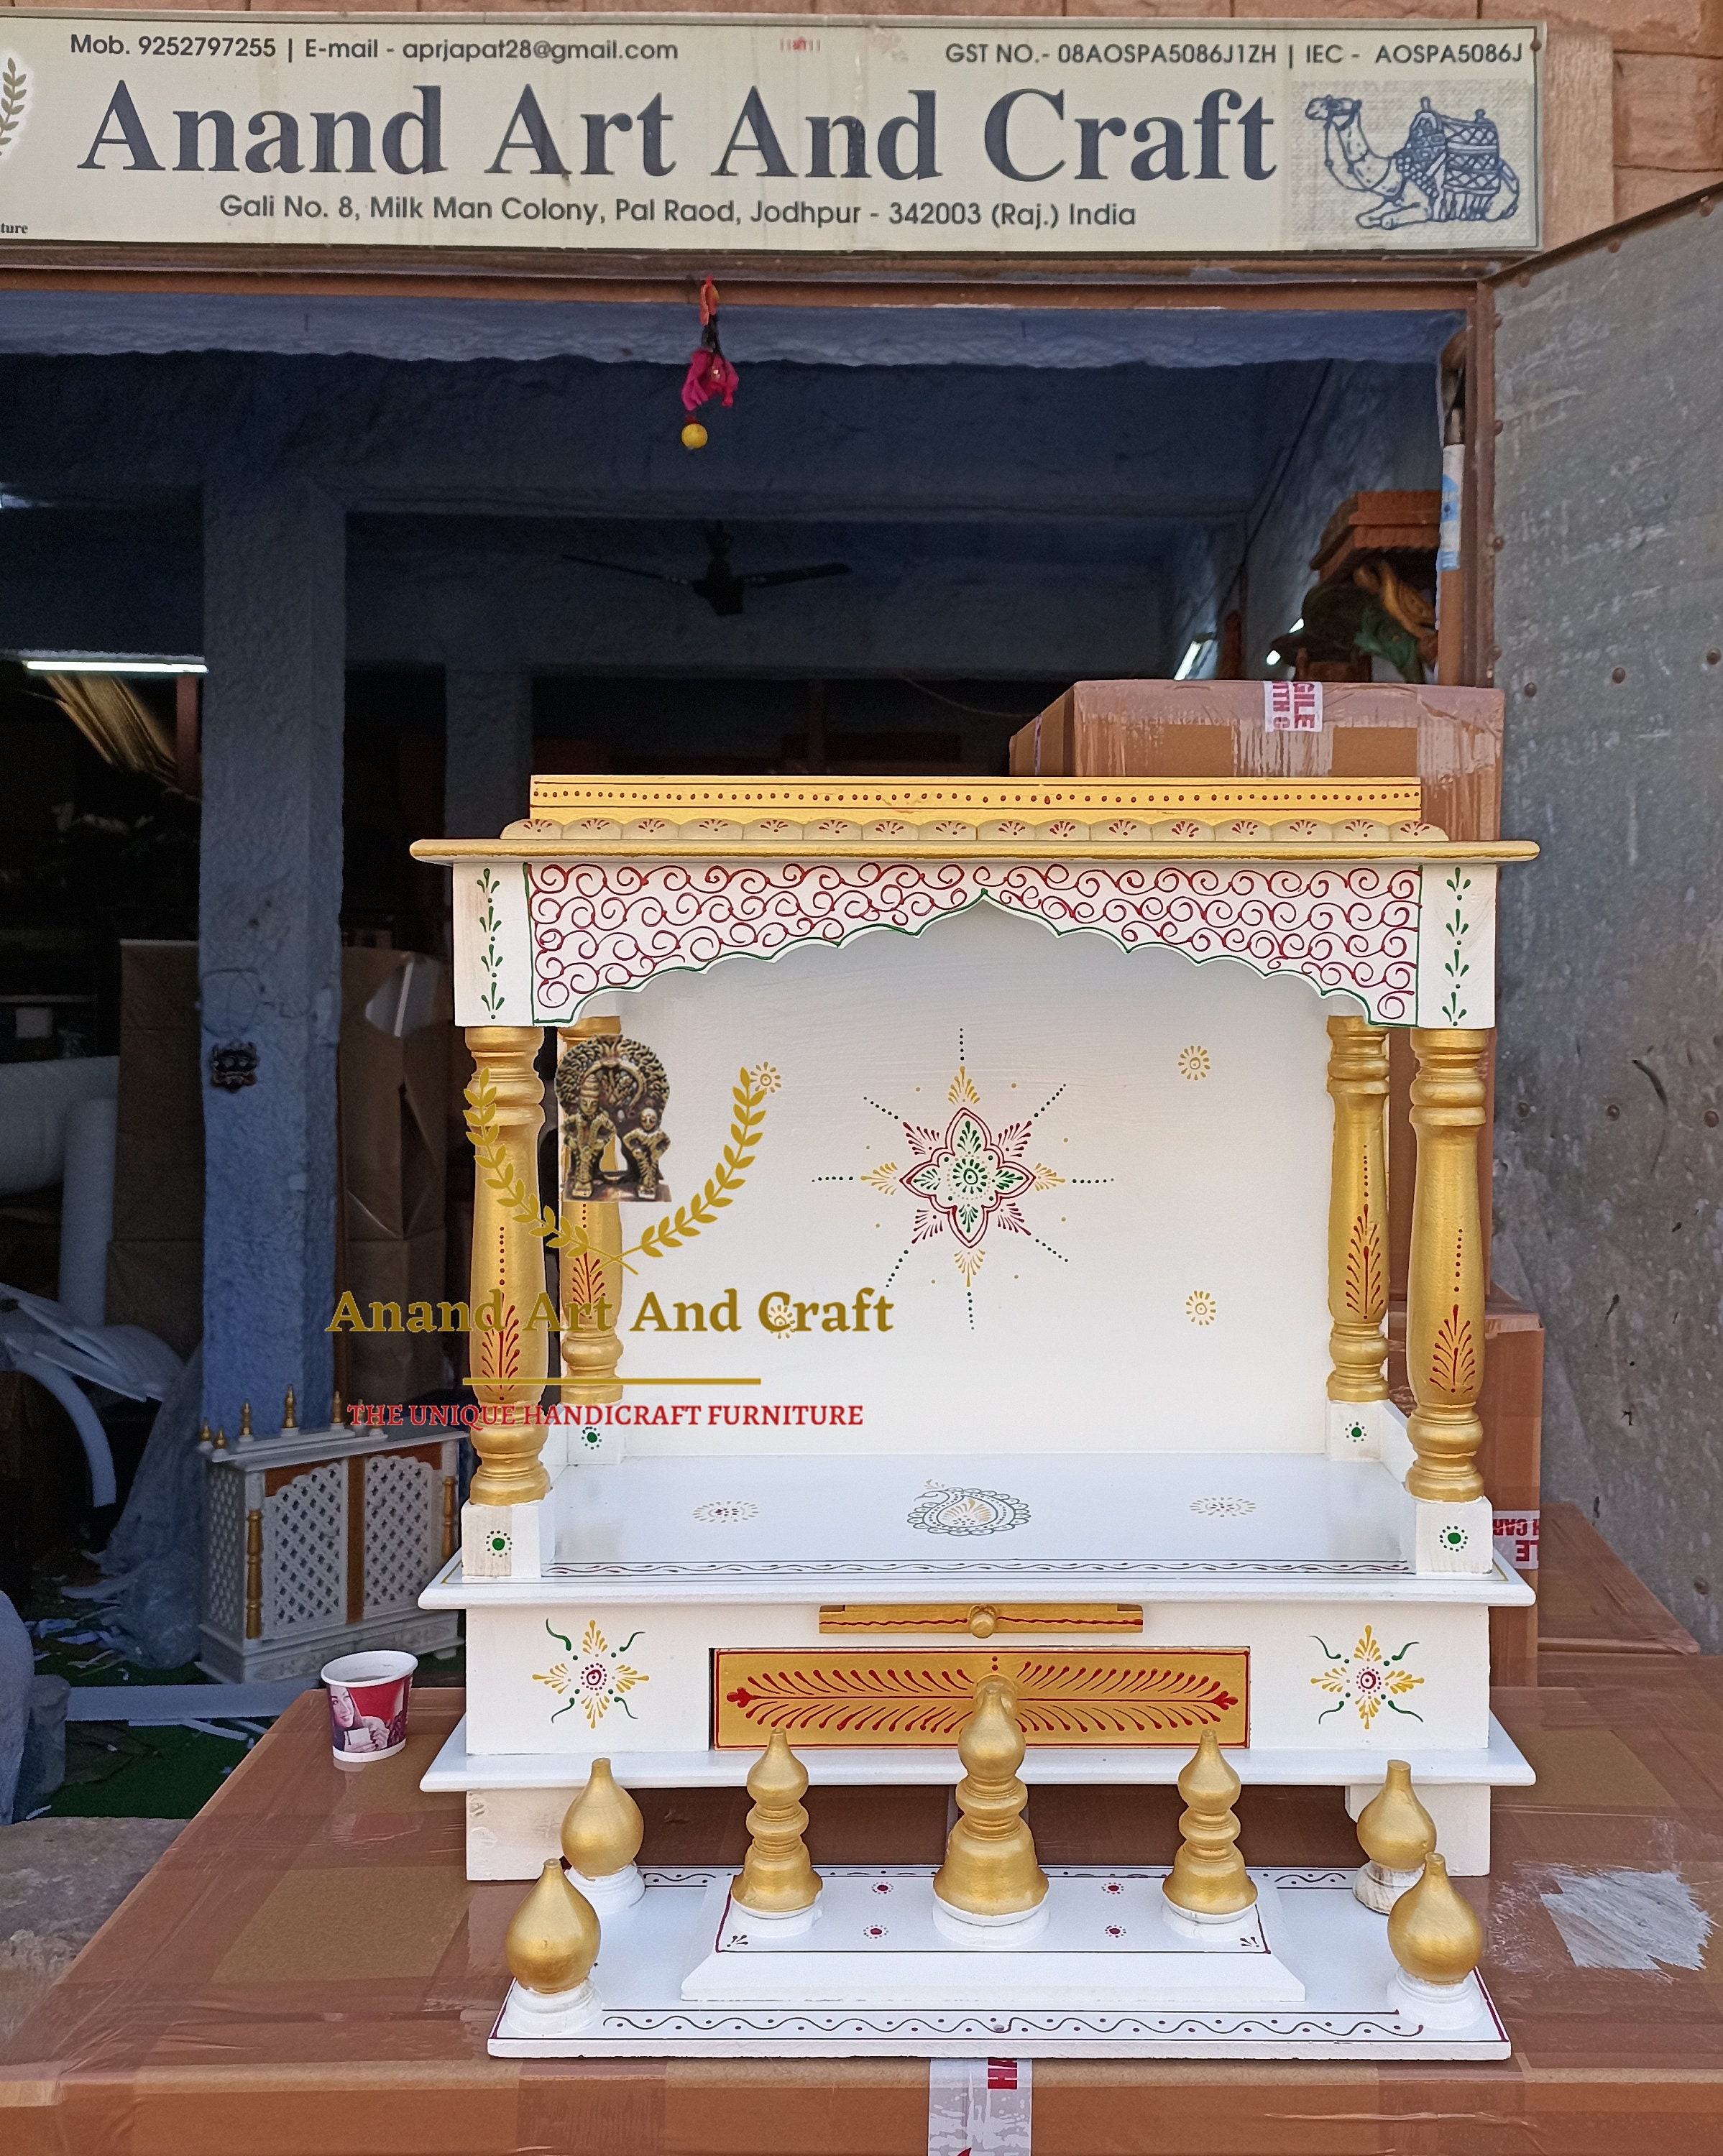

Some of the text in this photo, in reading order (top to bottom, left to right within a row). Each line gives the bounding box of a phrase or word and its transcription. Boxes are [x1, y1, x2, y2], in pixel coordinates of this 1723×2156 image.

[70, 34, 130, 55] Mob.
[138, 35, 276, 57] 9252797255
[305, 38, 378, 58] E-mail
[403, 39, 679, 65] aprjapat28@gmail.com
[945, 42, 988, 63] GST
[1306, 44, 1343, 64] IEC
[76, 79, 1277, 183] Anand Art And Craft
[220, 194, 275, 217] Gali
[284, 195, 328, 218] No.
[338, 195, 360, 221] 8,
[370, 195, 424, 219] Milk
[433, 196, 492, 219] Man
[501, 196, 605, 226] Colony,
[616, 198, 655, 221] Pal
[664, 198, 741, 226] Raod,
[750, 200, 861, 229] Jodhpur
[888, 201, 982, 225] 342003
[991, 203, 1059, 231] (Raj.)
[1070, 203, 1135, 226] India
[1493, 1519, 1527, 1536] CAR
